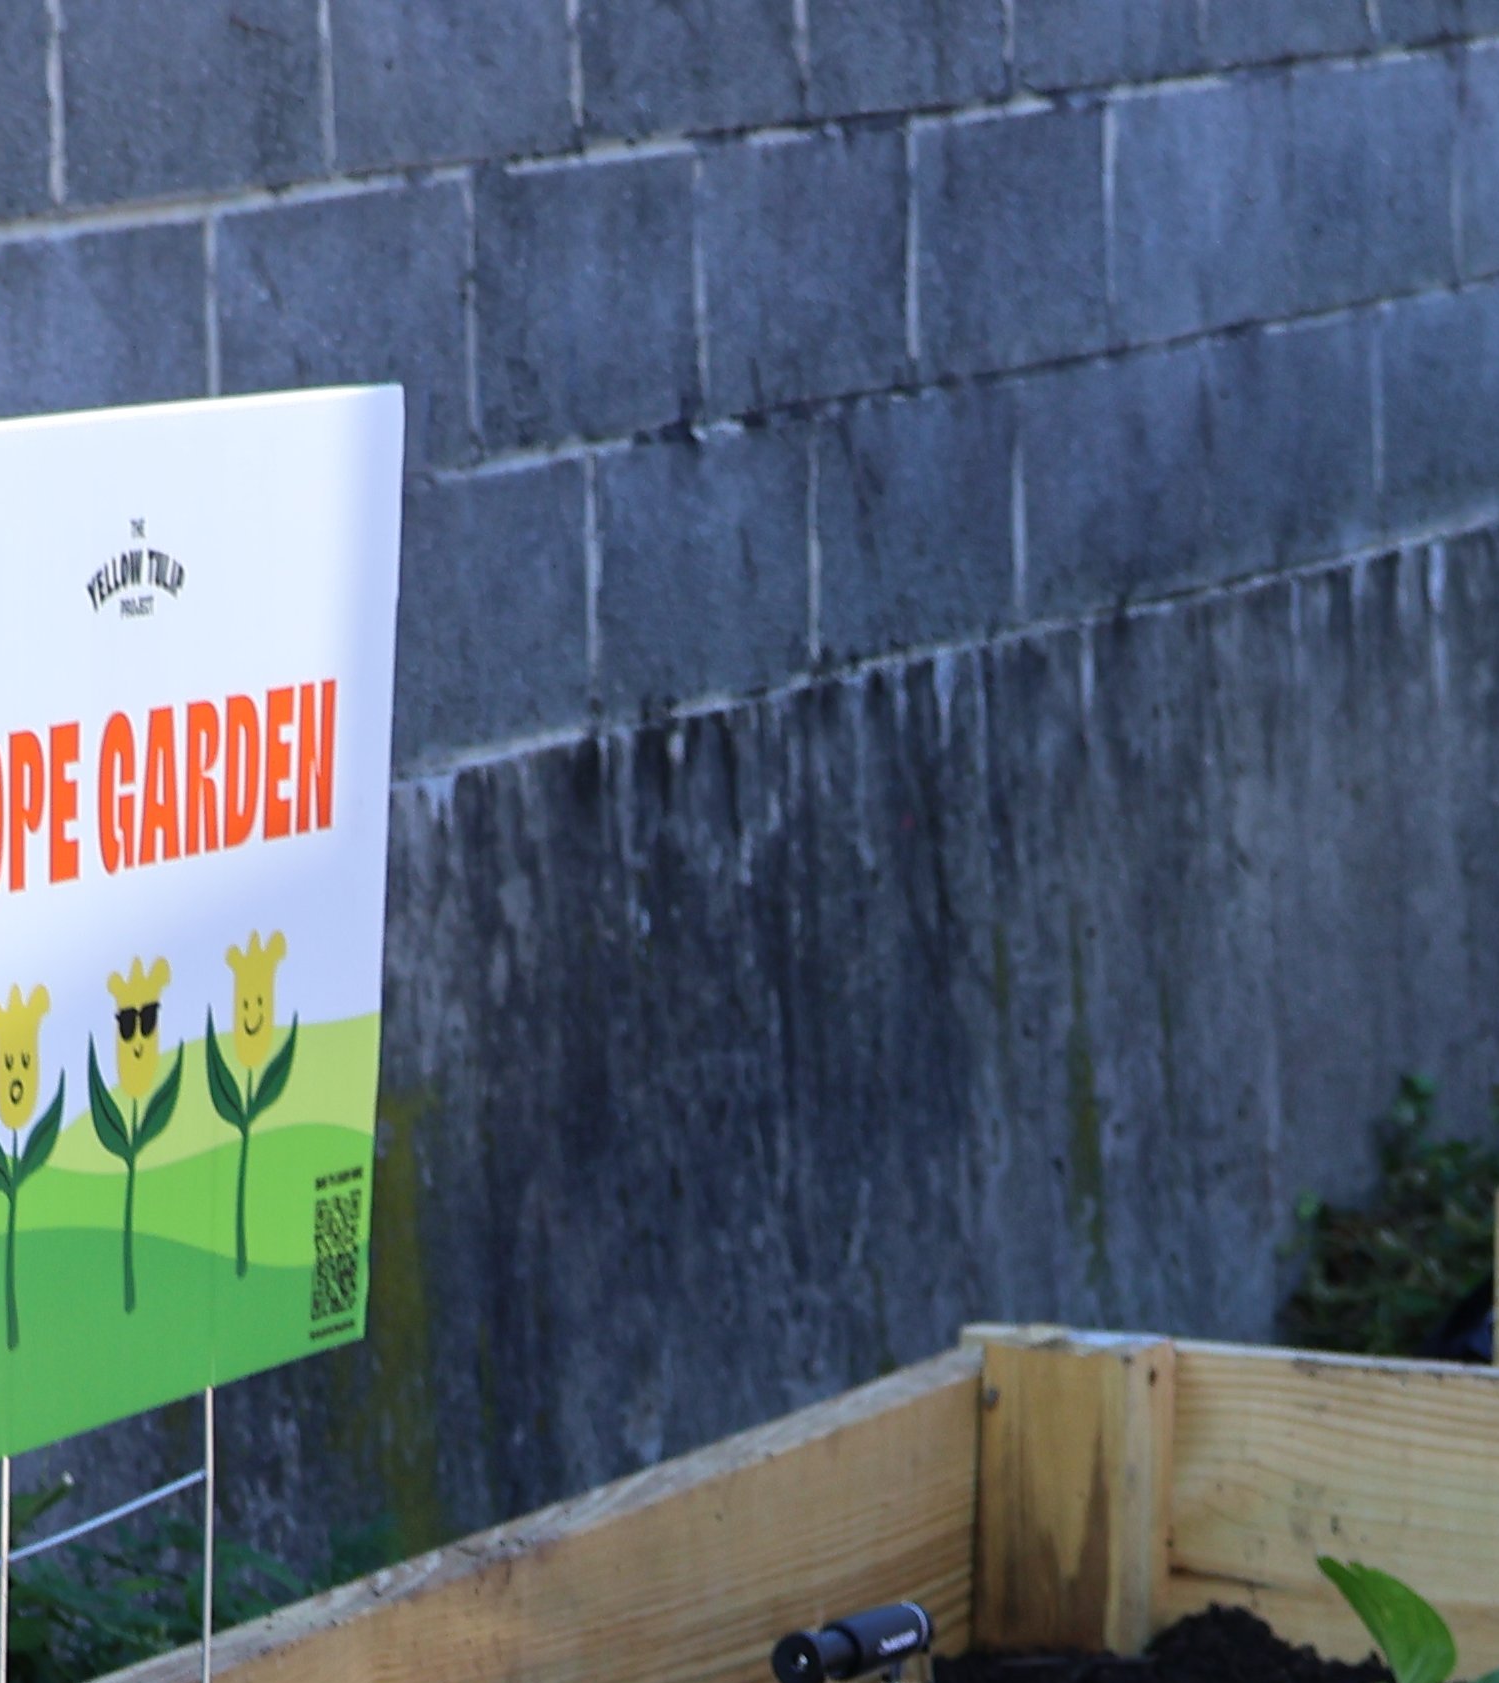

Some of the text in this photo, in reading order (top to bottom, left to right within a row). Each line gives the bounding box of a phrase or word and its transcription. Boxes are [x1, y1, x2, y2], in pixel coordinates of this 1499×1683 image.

[87, 548, 184, 613] YELLOW TULIP
[98, 678, 337, 876] GARDEN
